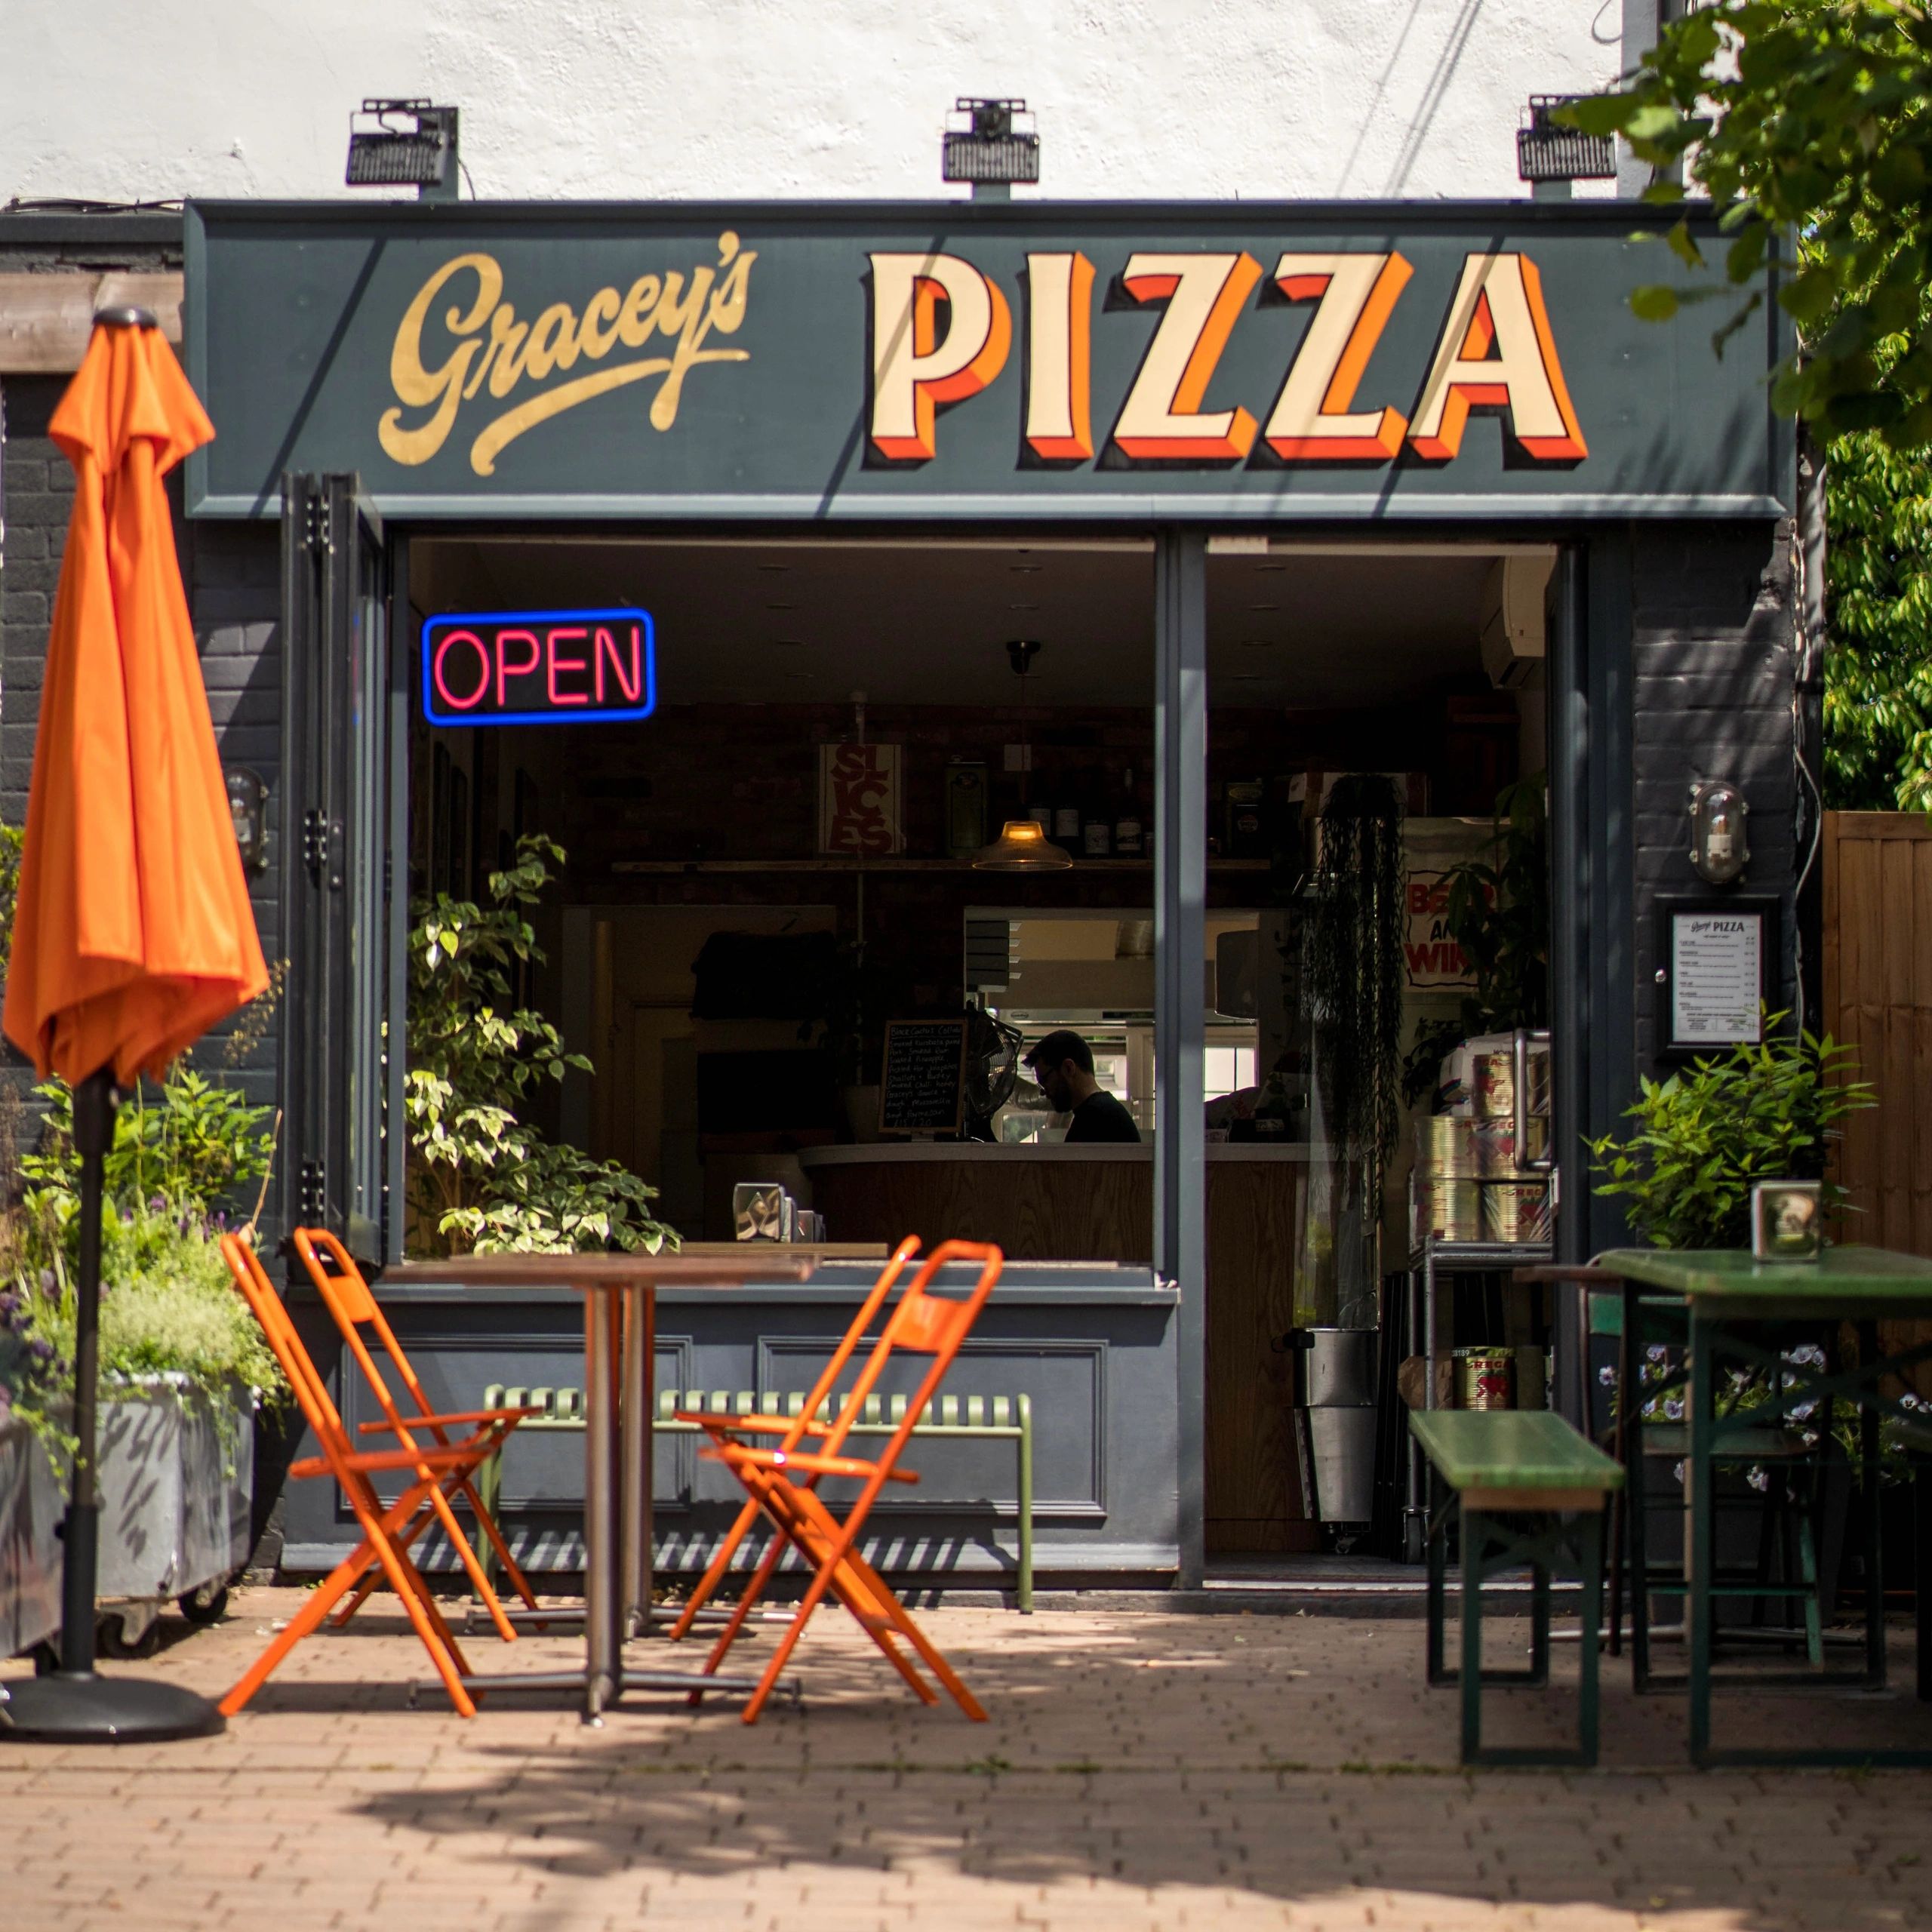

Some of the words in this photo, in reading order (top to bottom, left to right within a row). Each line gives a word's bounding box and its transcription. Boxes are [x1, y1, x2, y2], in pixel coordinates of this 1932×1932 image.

[378, 230, 758, 477] Gracey's
[860, 251, 1589, 469] PIZZA
[434, 626, 641, 710] OPEN
[1407, 884, 1496, 914] BE
[1713, 921, 1745, 932] PIZZA
[1404, 943, 1488, 973] WIN
